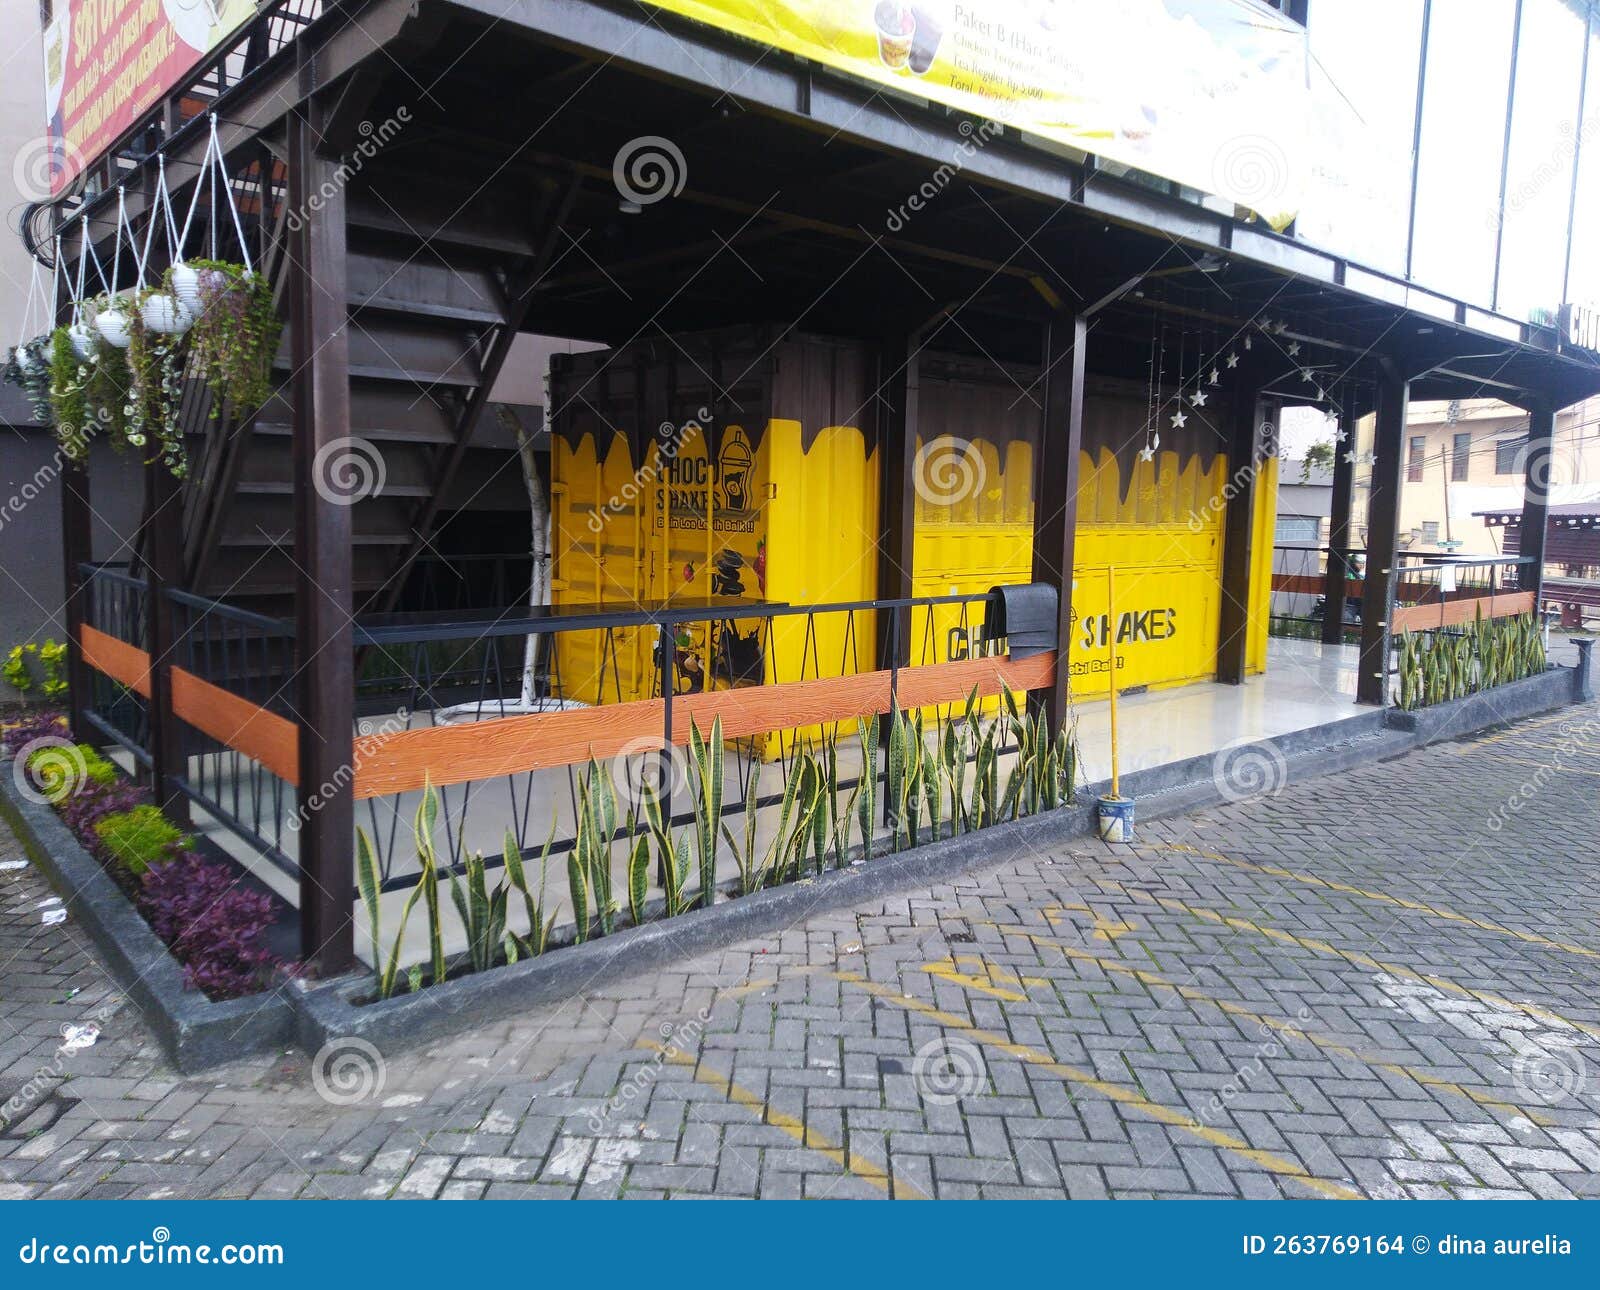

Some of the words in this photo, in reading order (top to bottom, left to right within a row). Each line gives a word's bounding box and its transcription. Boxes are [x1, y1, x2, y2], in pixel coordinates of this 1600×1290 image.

[955, 4, 992, 36] Paket
[997, 23, 1005, 42] B
[950, 73, 973, 94] Total
